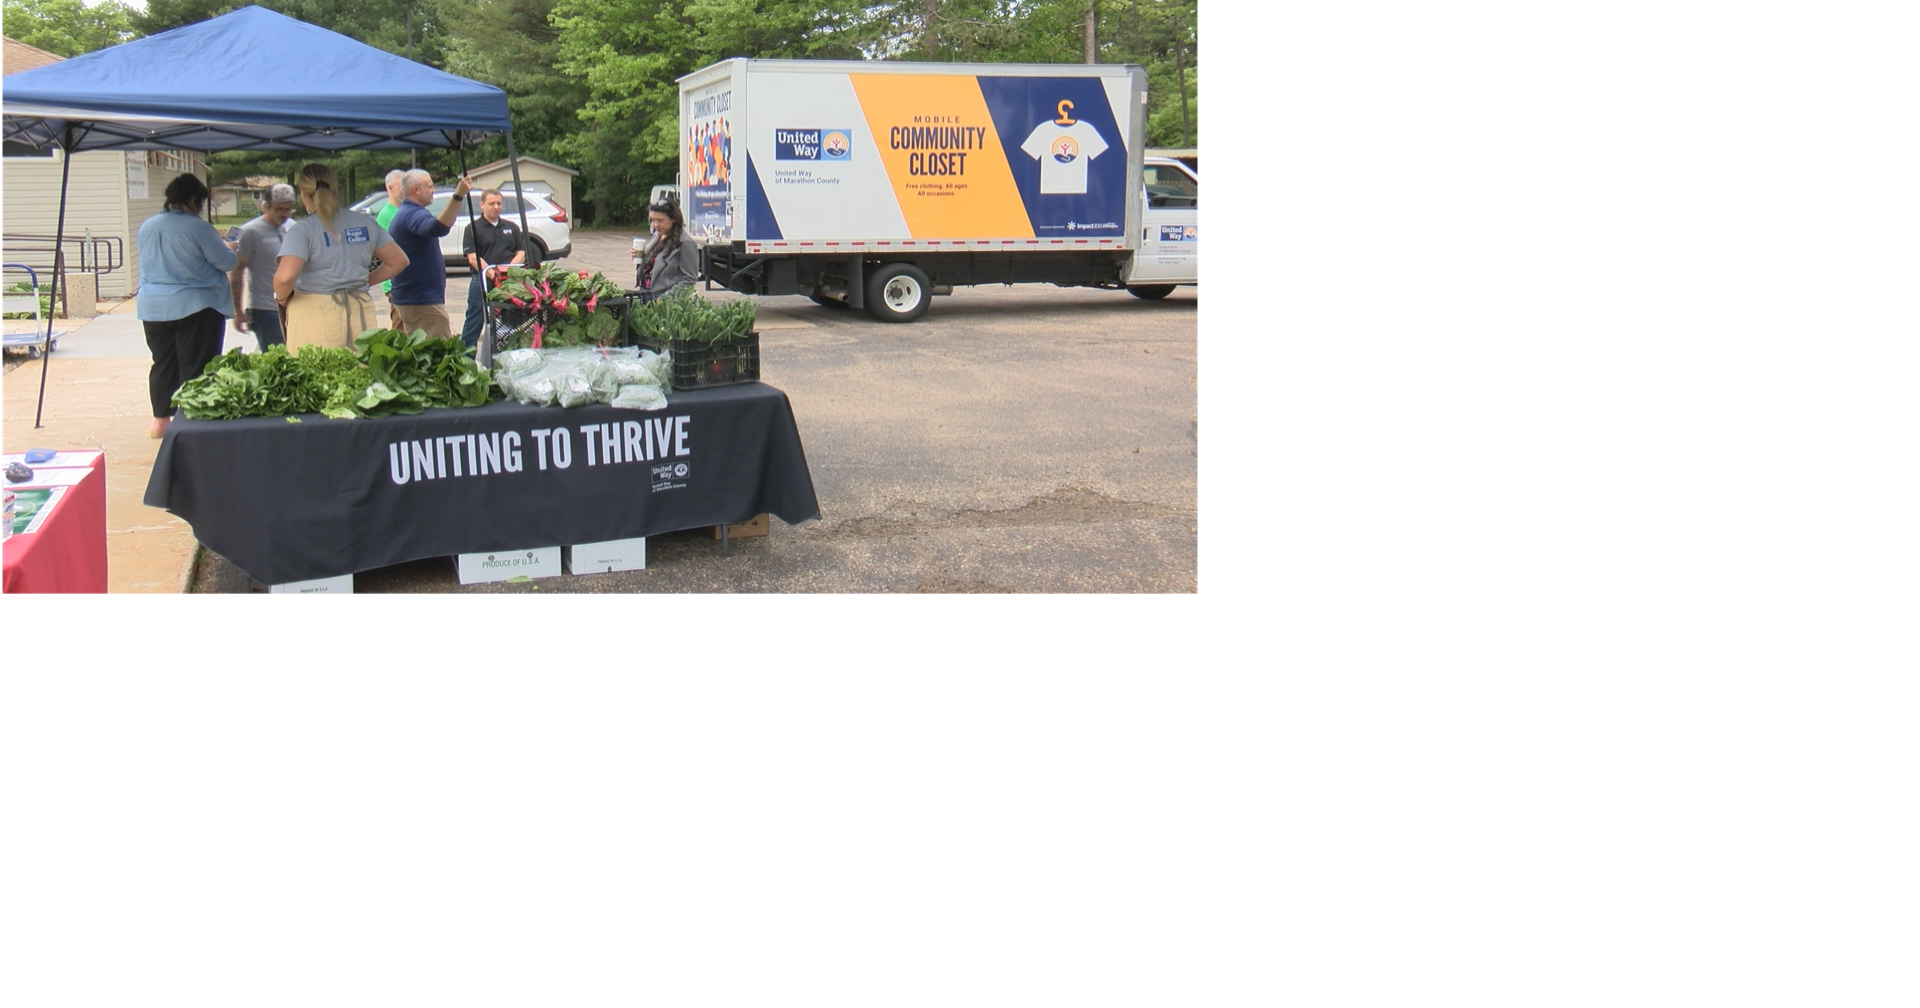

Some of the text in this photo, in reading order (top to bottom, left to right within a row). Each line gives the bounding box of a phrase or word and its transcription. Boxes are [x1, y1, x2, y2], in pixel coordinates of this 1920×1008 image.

[694, 96, 716, 119] COMMUNITY
[914, 115, 960, 123] MOBILE
[777, 131, 819, 144] United
[890, 126, 986, 150] COMMUNITY
[793, 144, 819, 159] Way
[909, 152, 967, 176] CLOSET
[816, 177, 840, 185] County
[1169, 232, 1182, 240] Way
[389, 415, 691, 485] UNITING TO THRIVE
[652, 464, 672, 475] United
[482, 559, 512, 568] PRODUCE
[512, 558, 521, 566] OF
